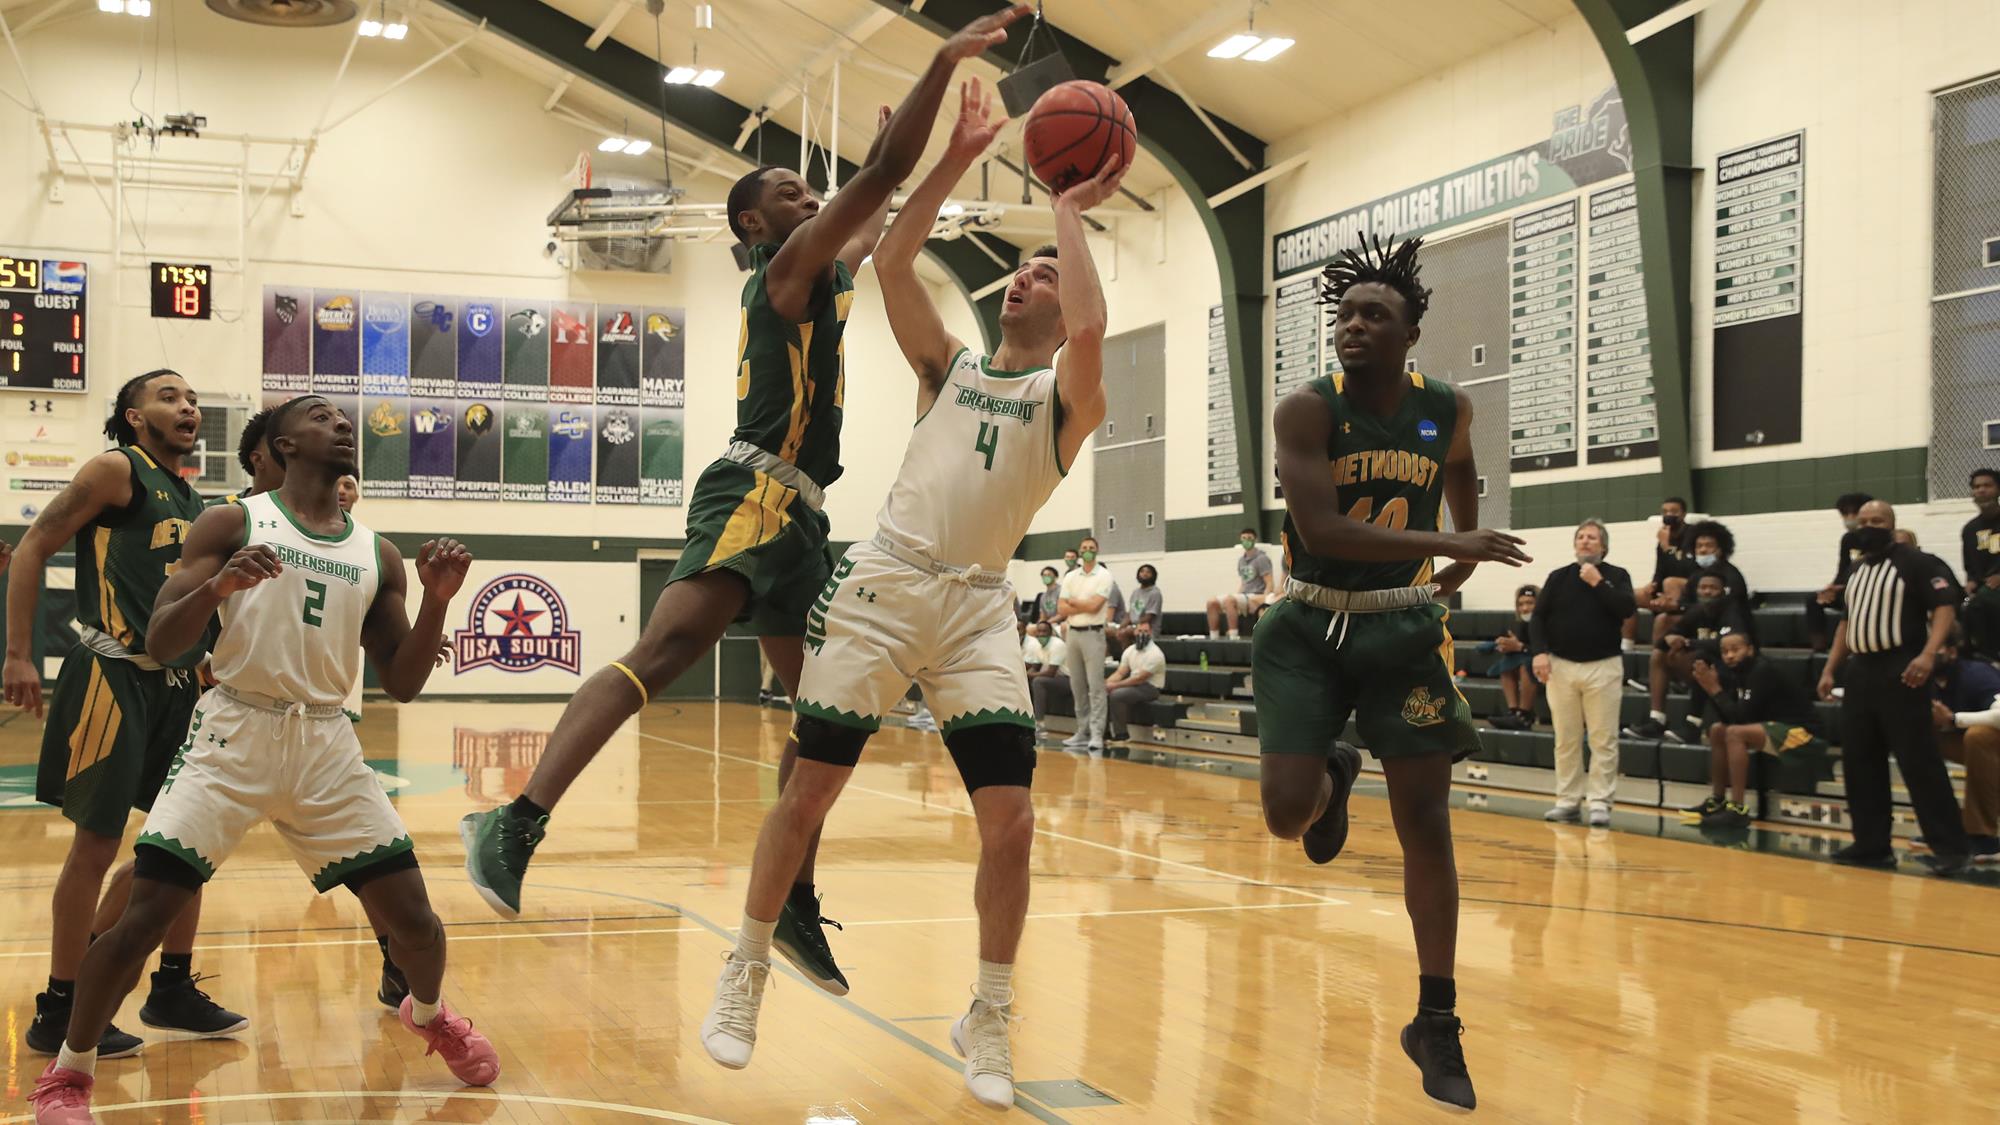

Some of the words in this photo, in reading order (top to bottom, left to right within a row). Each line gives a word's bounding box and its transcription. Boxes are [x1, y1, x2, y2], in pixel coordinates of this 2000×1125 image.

[1555, 106, 1579, 130] THE
[1549, 114, 1608, 164] PRIDE
[1719, 148, 1799, 181] CHAMPIONSHIPS
[1277, 208, 1368, 273] GREENSBORO
[1371, 184, 1440, 240] COLLEGE
[1442, 150, 1540, 222] ATHLETICS
[1591, 194, 1638, 218] CHAMPION
[1728, 202, 1751, 217] MEN'S
[1515, 210, 1575, 240] CHAMPIONSHIPS
[161, 266, 207, 286] 17:54
[34, 294, 80, 310] GUEST
[174, 285, 199, 316] 18
[73, 314, 80, 340] 1
[1, 340, 25, 351] FOUL
[53, 342, 84, 354] FOULS
[13, 351, 20, 372] 1
[72, 354, 79, 375] 1
[53, 378, 83, 390] SCORE
[314, 374, 360, 384] AVERETT
[363, 374, 409, 386] BEREA
[411, 378, 456, 388] BREVARD
[642, 378, 684, 391] MARY
[263, 380, 310, 391] COLLEGE
[314, 384, 360, 393] UNIVERSITY
[363, 385, 409, 395] COLLEGE
[458, 381, 501, 390] COVENANT
[504, 384, 548, 393] GREENSBORO
[411, 387, 456, 397] COLLEGE
[458, 389, 501, 399] COLLEGE
[504, 391, 548, 401] COLLEGE
[597, 387, 639, 396] LAGRANGE
[642, 390, 684, 399] BALDWIN
[550, 393, 593, 403] COLLEGE
[597, 395, 639, 405] COLLEGE
[642, 398, 684, 407] UNIVERSITY
[957, 385, 1036, 424] GREENSBORO
[413, 415, 436, 433] W
[1421, 428, 1438, 438] NCAA
[974, 421, 1000, 472] 4
[1331, 449, 1439, 492] METHODIST
[363, 480, 408, 489] METHODIST
[409, 481, 454, 490] WESLEYAN
[456, 481, 500, 491] PFEIFFER
[503, 483, 546, 492] PIEDMONT
[548, 481, 591, 493] SALEM
[640, 478, 682, 488] WILLIAM
[363, 489, 408, 498] UNIVERSITY
[409, 489, 454, 498] COLLEGE
[456, 490, 500, 499] UNIVERSITY
[597, 486, 639, 495] WESLEYAN
[640, 486, 682, 498] PEACE
[503, 492, 546, 501] COLLEGE
[548, 492, 591, 502] COLLEGE
[597, 494, 639, 504] COLLEGE
[640, 497, 682, 505] UNIVERSITY
[277, 545, 362, 585] GREENSBORO
[302, 578, 327, 628] 2
[511, 579, 563, 633] CONFERENCE
[463, 638, 501, 663] USA
[510, 637, 574, 663] SOUTH
